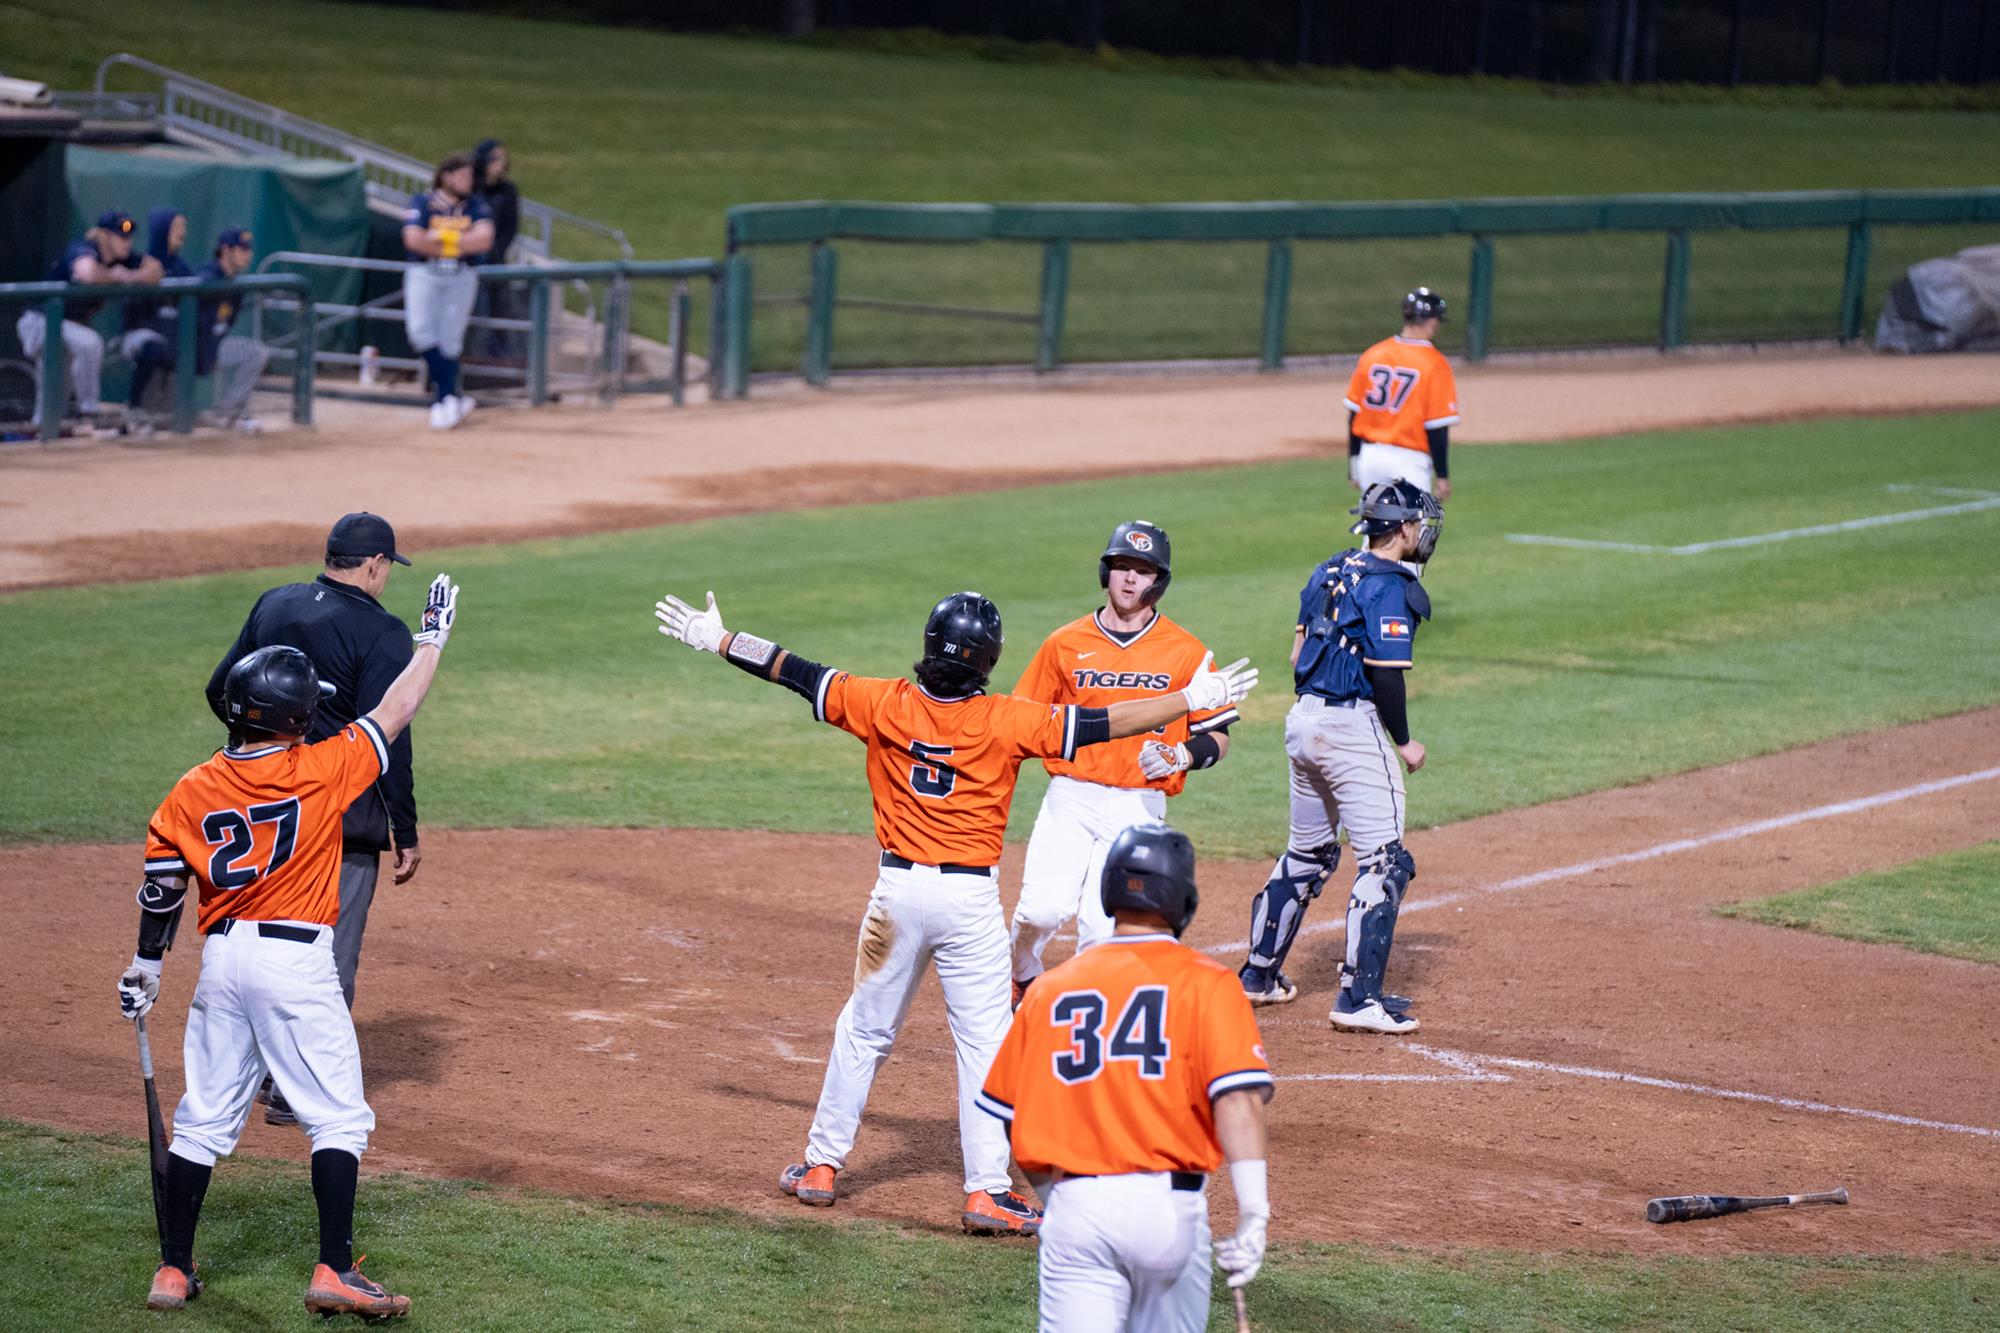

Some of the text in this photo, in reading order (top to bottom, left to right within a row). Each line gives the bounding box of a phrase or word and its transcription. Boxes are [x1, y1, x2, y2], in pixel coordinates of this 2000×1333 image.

[1362, 364, 1420, 414] 37
[1072, 669, 1171, 691] TIGERS
[908, 739, 956, 799] 5
[201, 796, 301, 890] 27
[1050, 985, 1170, 1086] 34
